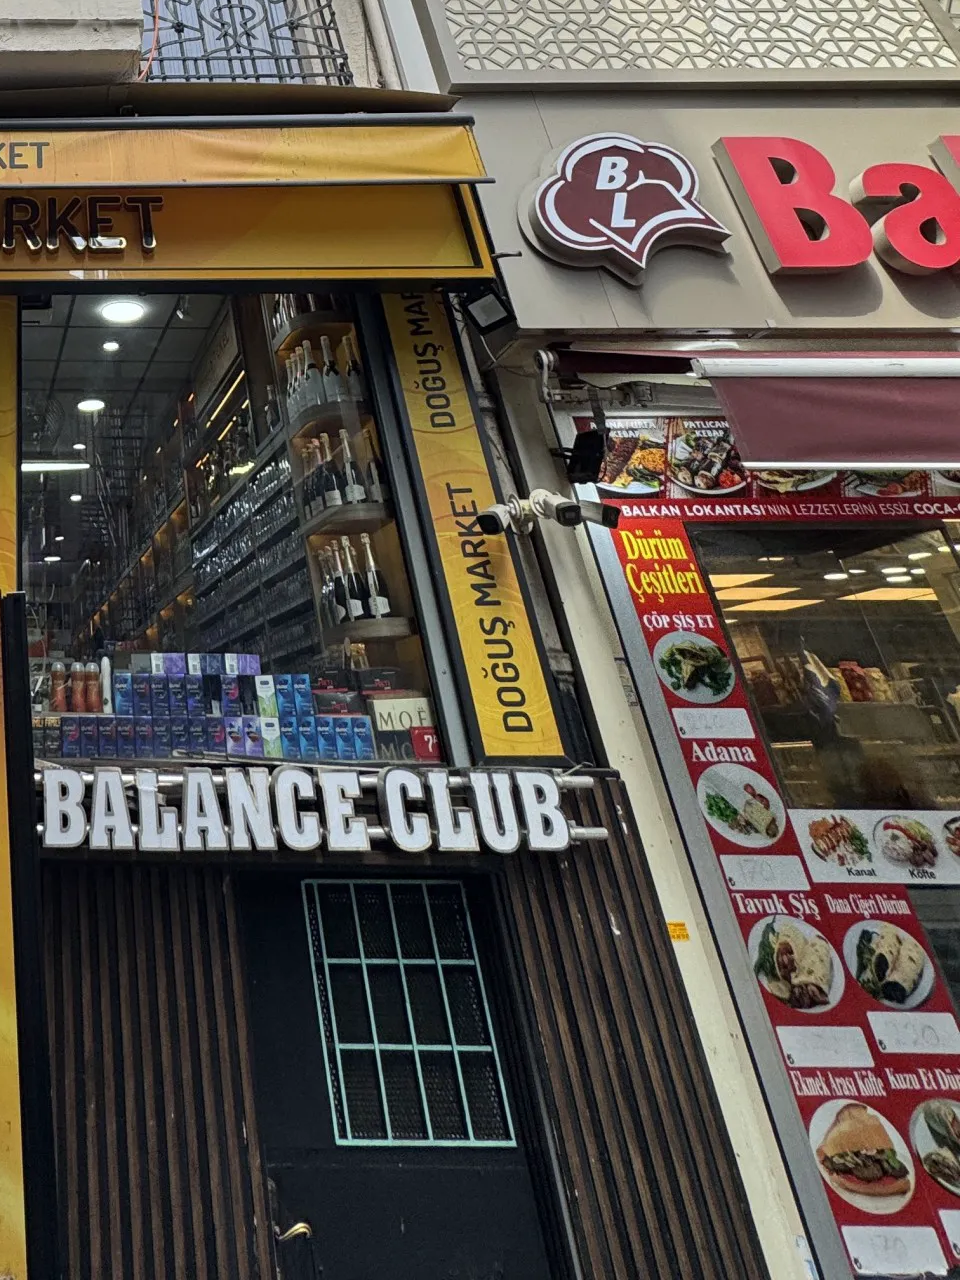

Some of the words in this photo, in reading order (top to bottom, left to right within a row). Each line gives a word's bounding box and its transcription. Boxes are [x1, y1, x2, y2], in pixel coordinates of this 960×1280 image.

[413, 342, 456, 429] DOĞUŞ
[621, 504, 681, 517] BALKAN
[880, 502, 913, 517] EŞSİZ
[445, 482, 502, 607] MARKET
[619, 529, 688, 560] Dürüm
[625, 563, 707, 603] Çeşitleri
[643, 612, 670, 632] ÇÖP
[672, 611, 696, 632] ŞİŞ
[697, 614, 715, 629] ET
[480, 615, 535, 734] DOĞUŞ
[692, 741, 757, 763] Adana
[41, 766, 372, 853] BALANCE
[378, 766, 570, 853] CLUB
[846, 867, 877, 878] Kanat
[908, 868, 937, 880] Köfte
[731, 893, 788, 915] Tavuk
[789, 892, 821, 920] Şiş
[824, 893, 852, 914] Dana
[876, 894, 912, 915] Dürüm
[790, 1071, 830, 1097] Ekmek
[829, 1072, 858, 1097] Arası
[853, 1071, 887, 1097] Köfte
[884, 1068, 921, 1090] Kuzu
[917, 1067, 938, 1090] Et
